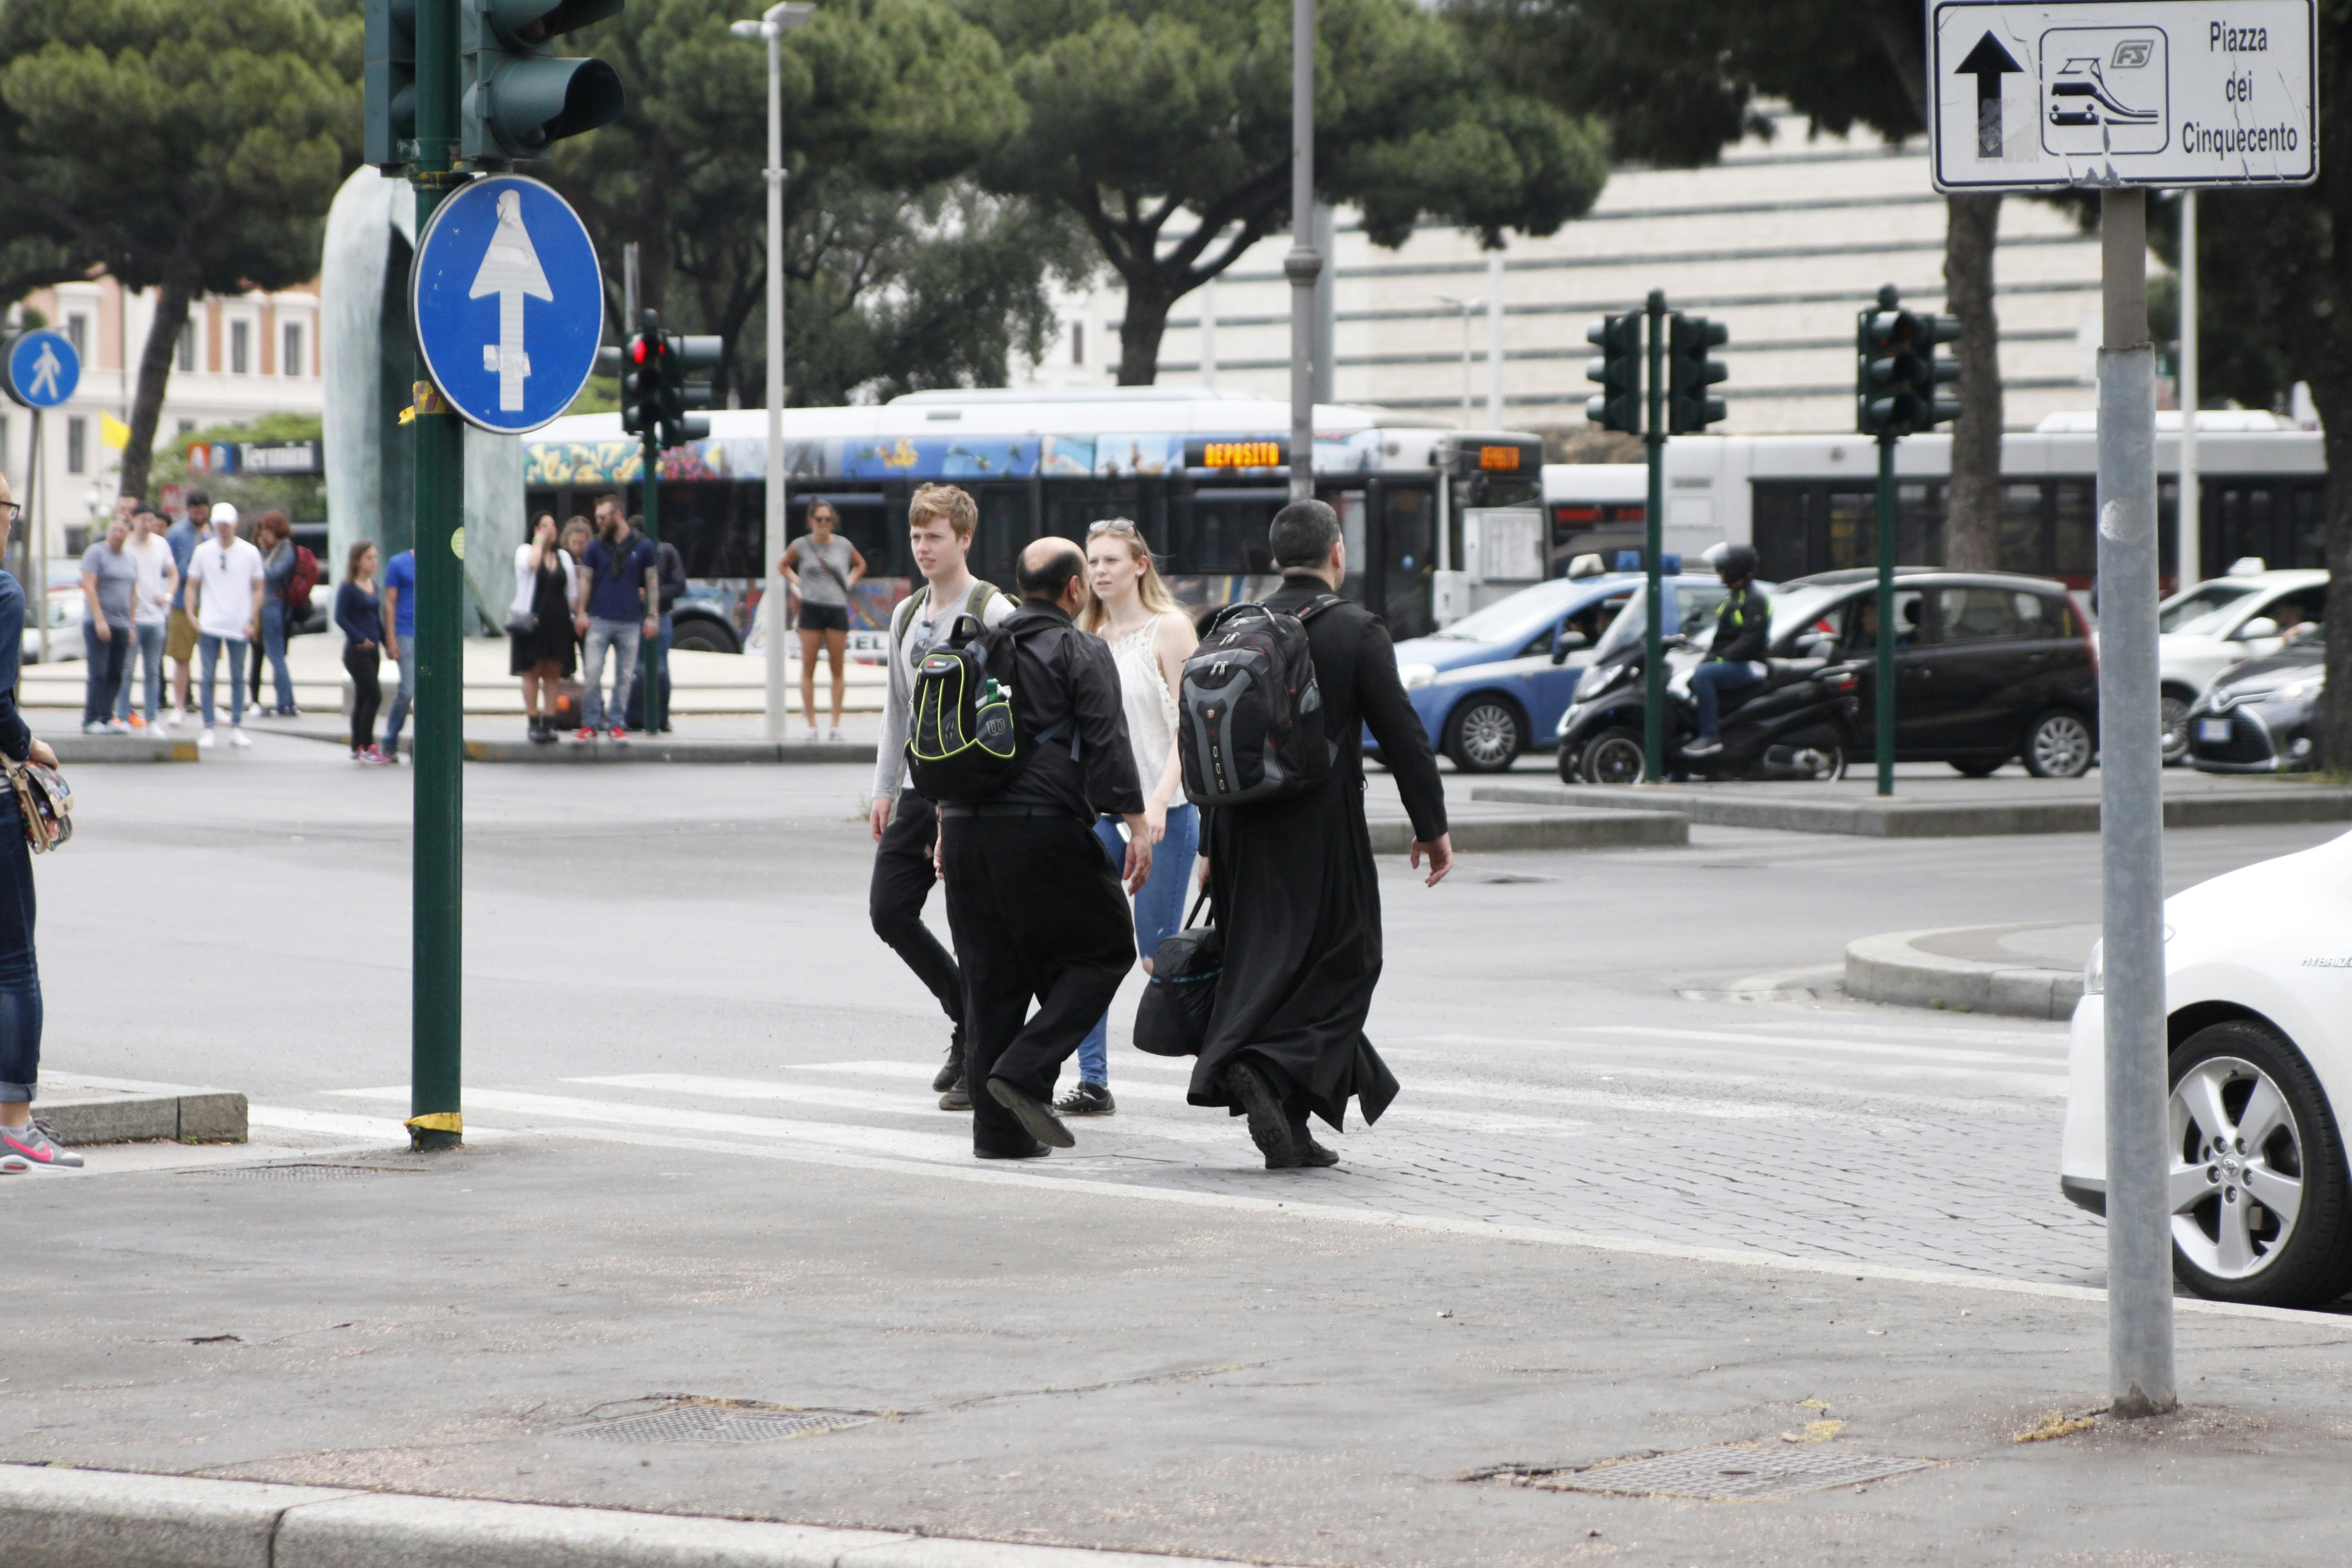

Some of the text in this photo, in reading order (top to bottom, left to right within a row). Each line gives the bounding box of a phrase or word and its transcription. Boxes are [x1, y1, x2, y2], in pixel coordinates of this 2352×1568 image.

[2210, 20, 2267, 51] Piazza
[2116, 45, 2148, 64] FS
[2226, 70, 2252, 102] dei
[2183, 121, 2297, 160] Cinquecento
[1204, 442, 1279, 467] DEPOSITO
